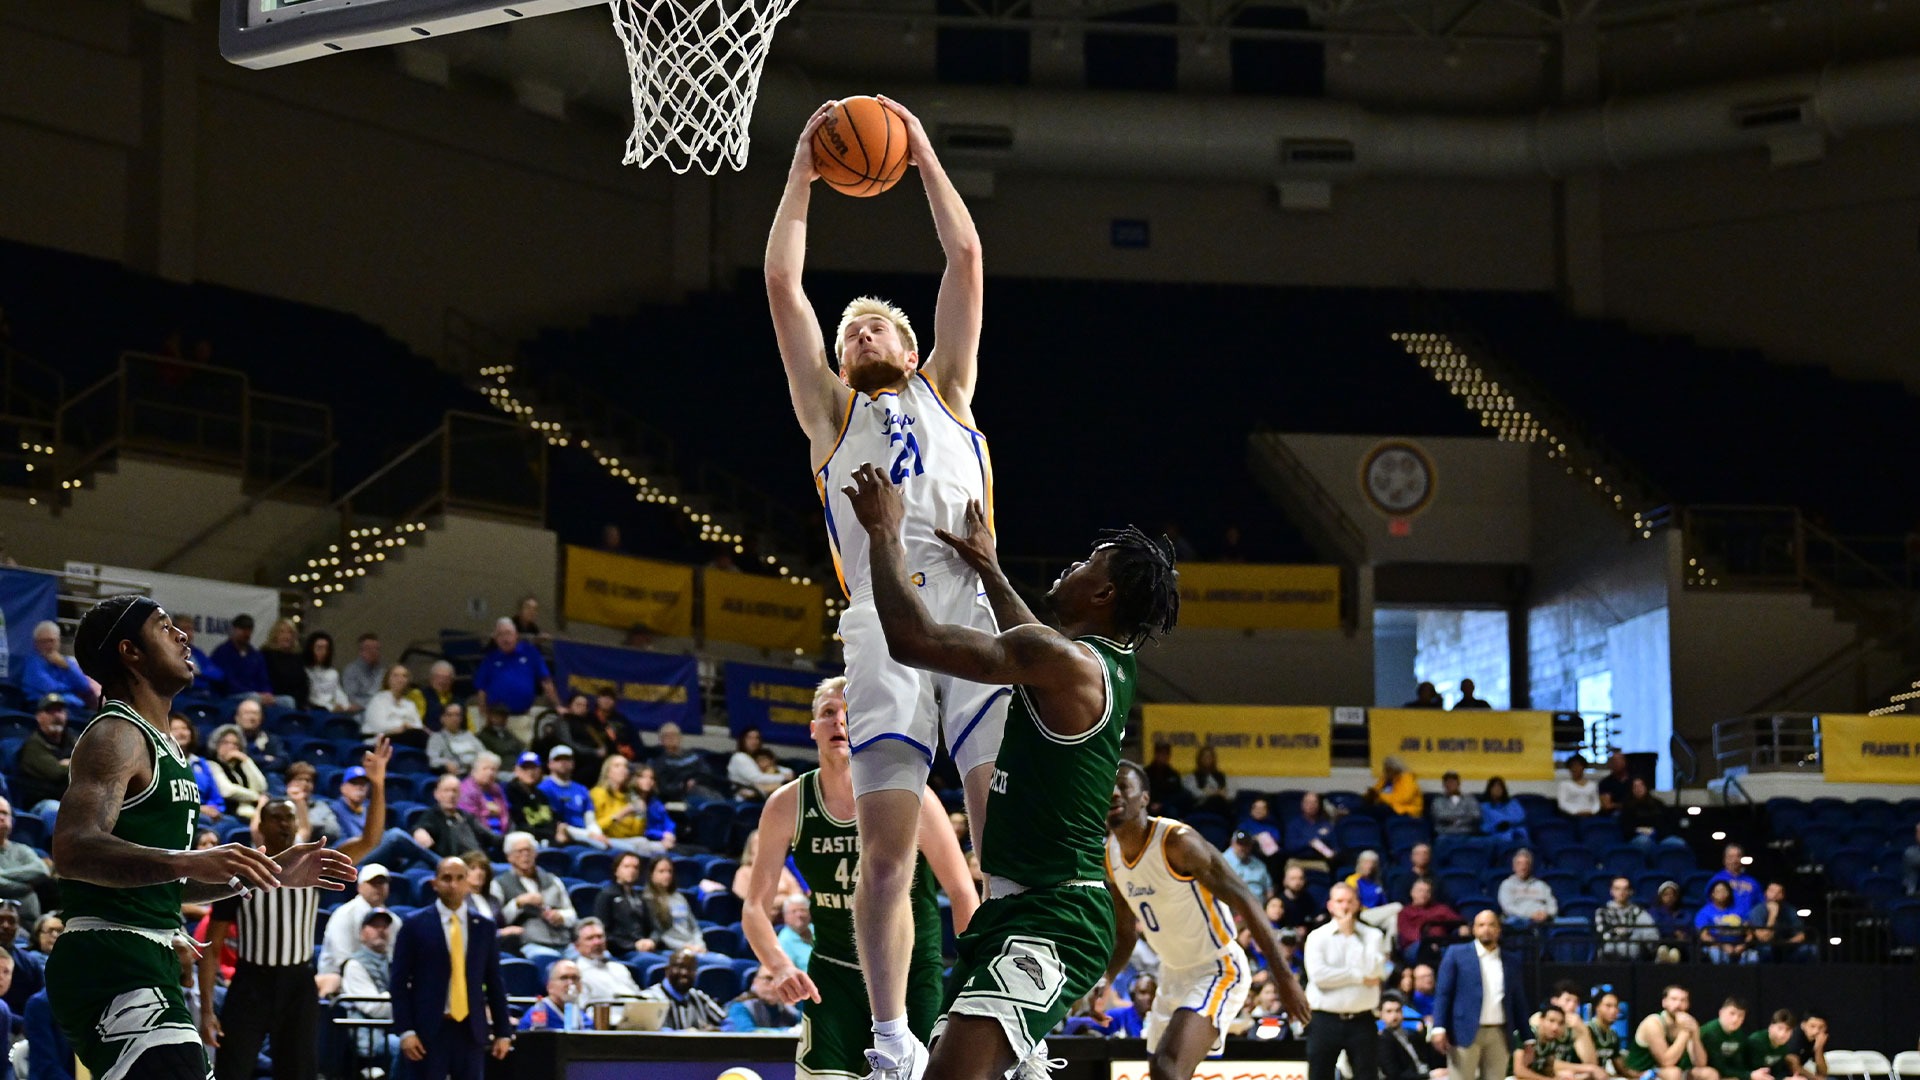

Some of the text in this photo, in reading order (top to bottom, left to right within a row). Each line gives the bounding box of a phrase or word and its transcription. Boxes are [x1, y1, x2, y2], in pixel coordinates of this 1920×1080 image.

[890, 432, 925, 485] 21
[814, 891, 842, 909] NEW
[1139, 901, 1160, 932] 0
